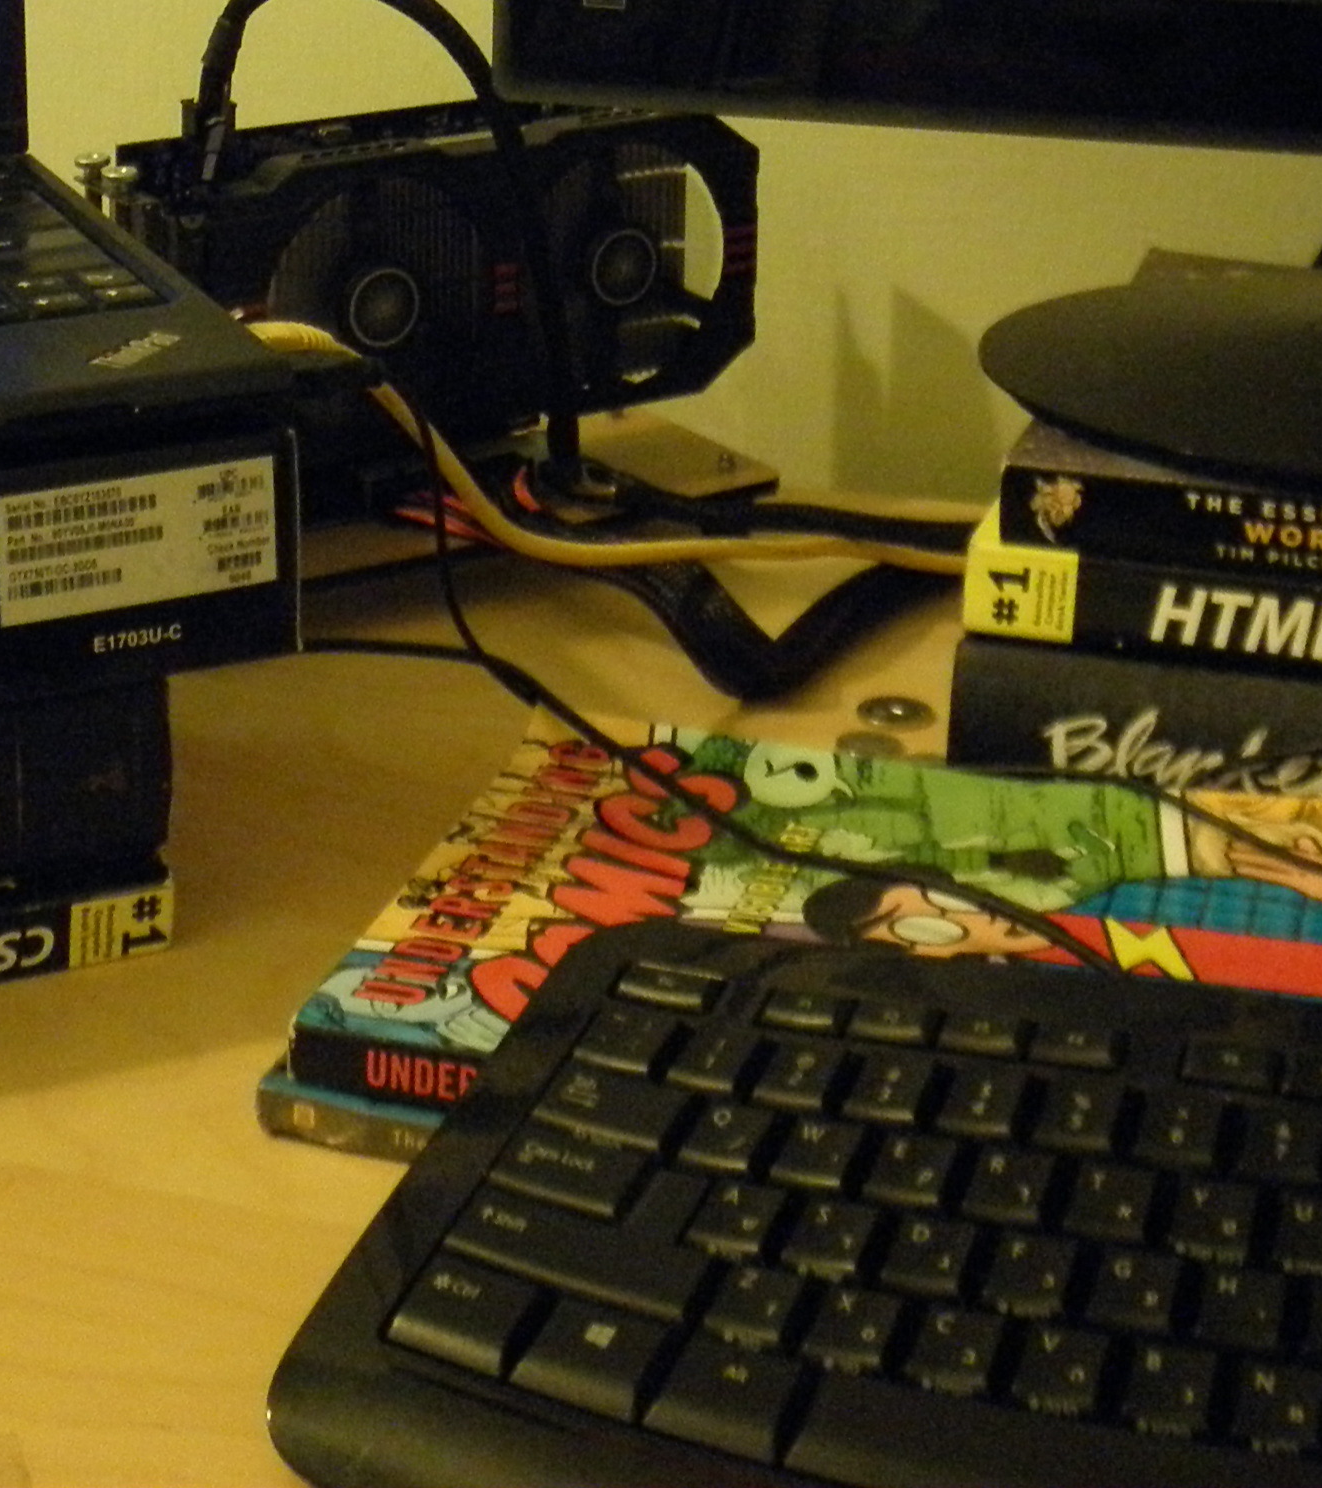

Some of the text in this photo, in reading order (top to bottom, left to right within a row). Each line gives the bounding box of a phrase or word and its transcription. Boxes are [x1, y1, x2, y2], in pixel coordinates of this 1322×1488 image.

[1186, 492, 1244, 516] THE
[1215, 544, 1255, 562] TIM
[988, 567, 1031, 626] #1
[92, 623, 182, 655] E1703U-C
[120, 893, 169, 959] #1
